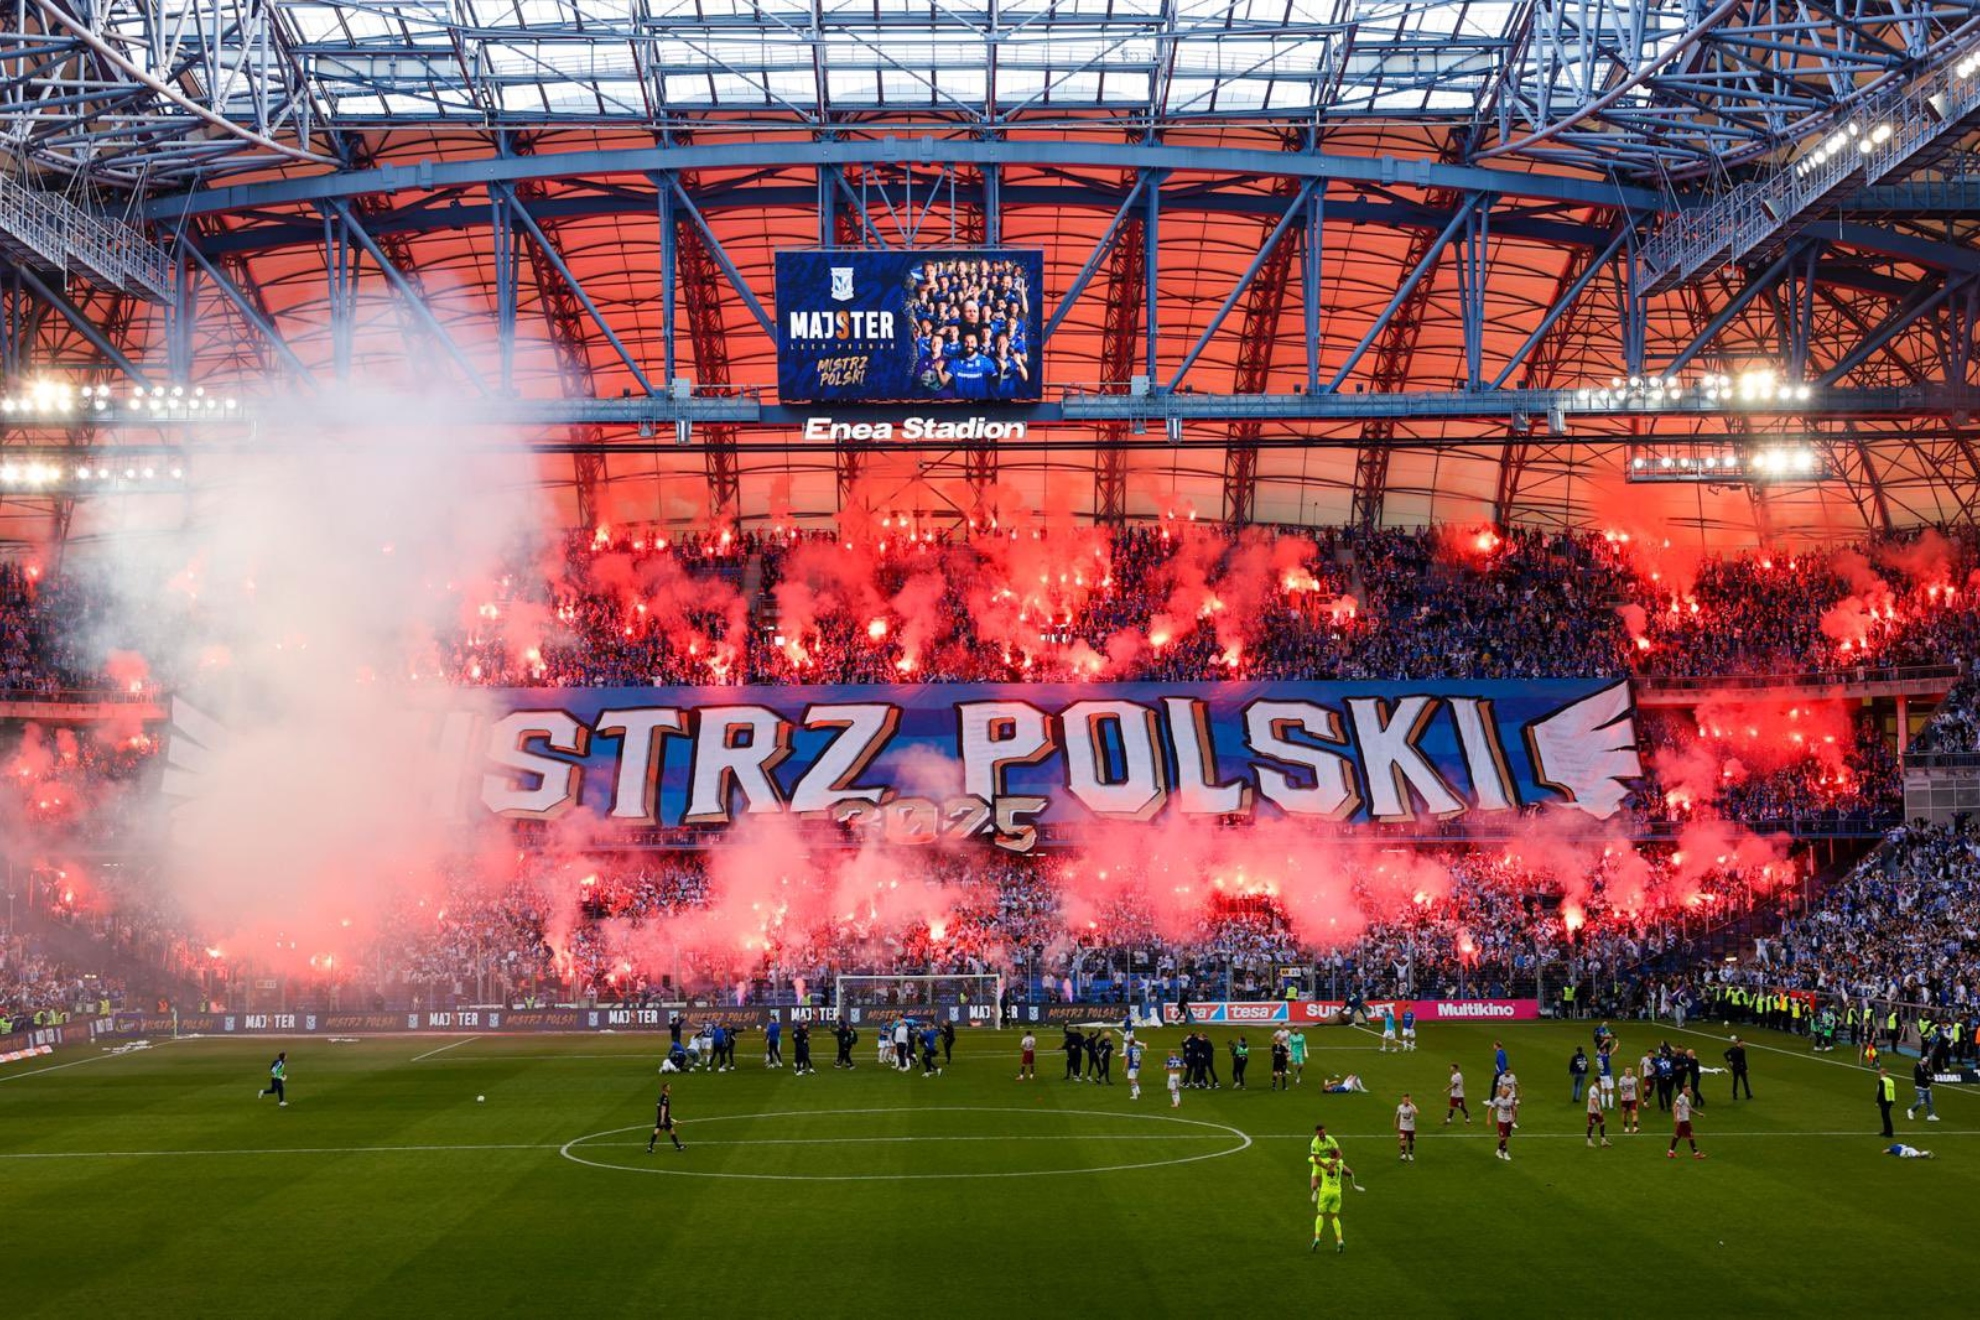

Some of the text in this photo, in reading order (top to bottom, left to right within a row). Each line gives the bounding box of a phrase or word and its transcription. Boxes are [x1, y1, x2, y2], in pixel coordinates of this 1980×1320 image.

[790, 311, 895, 339] MAJSTER
[817, 355, 869, 372] MISTRZ
[820, 369, 866, 387] POLSKI
[804, 417, 1025, 440] Enea Stadion
[446, 694, 1522, 828] STRZ POLSKI
[832, 796, 1050, 852] 2025
[608, 1010, 658, 1024] MAJSTER
[1168, 1004, 1208, 1019] tsa
[1231, 1003, 1269, 1018] tesa
[1306, 1002, 1396, 1019] SUPBET
[1437, 1003, 1515, 1017] Multikino
[245, 1014, 295, 1029] MAJSTER
[429, 1012, 478, 1026] MAJSTER
